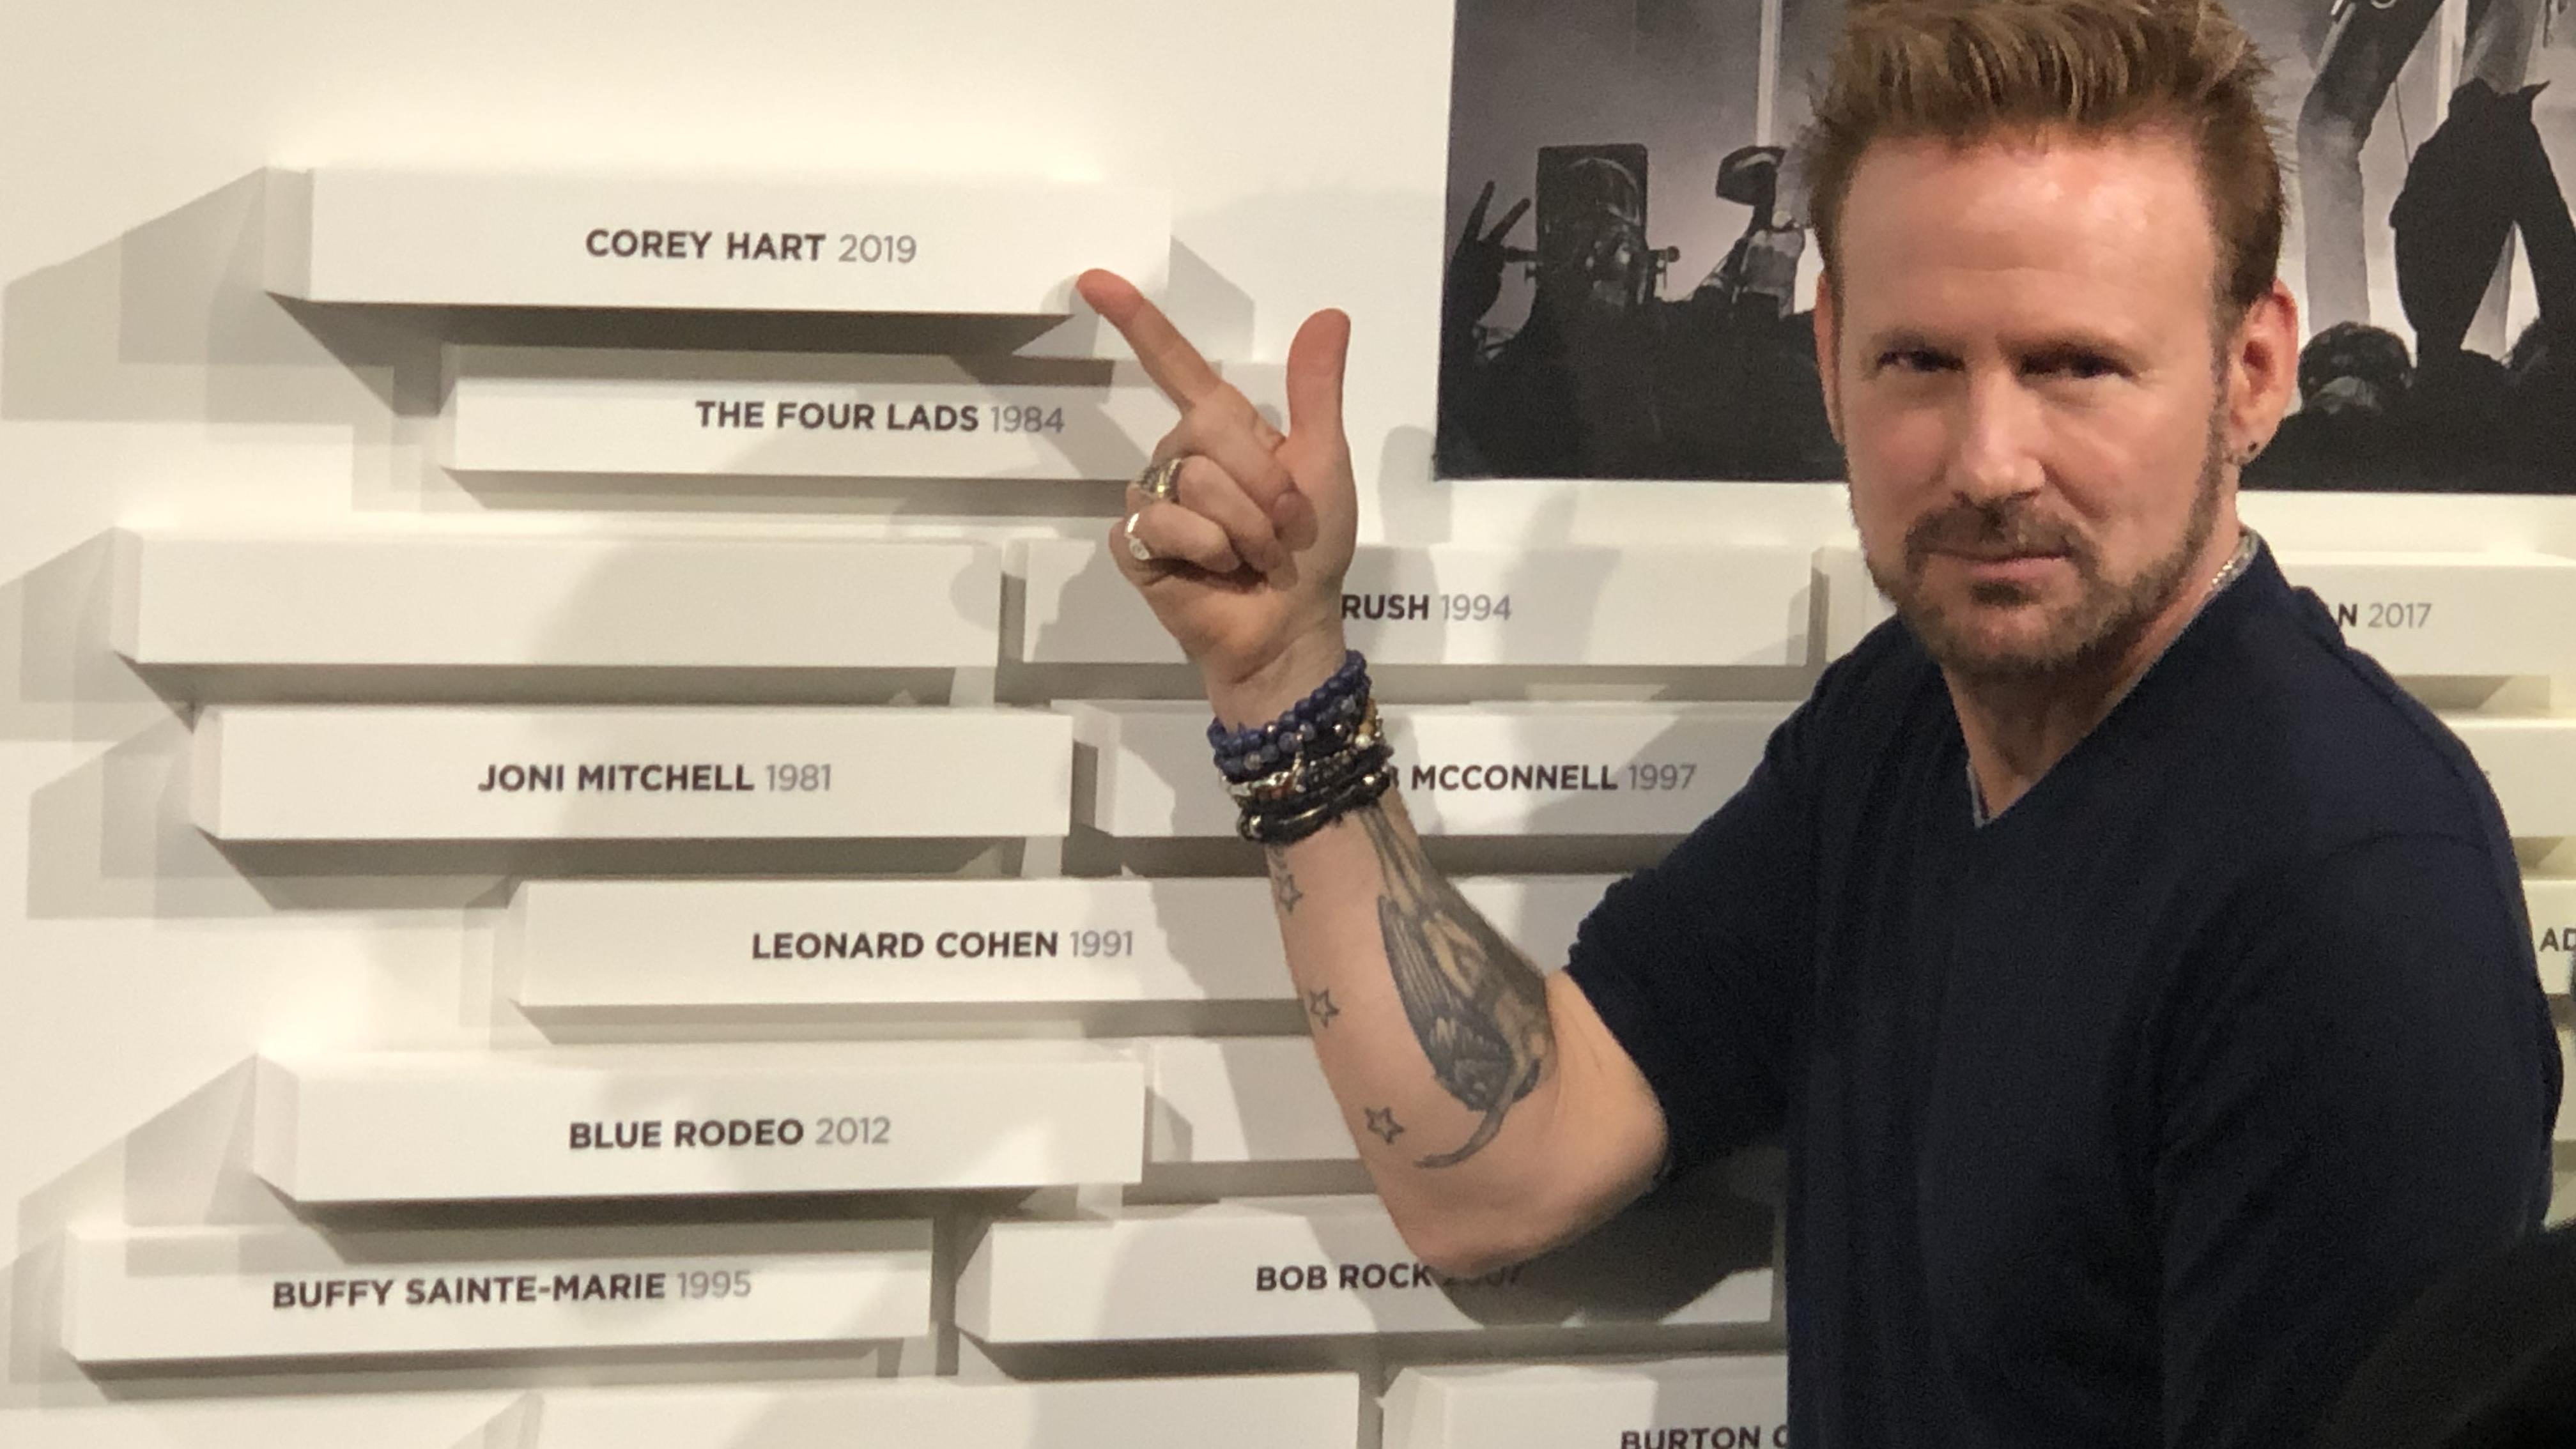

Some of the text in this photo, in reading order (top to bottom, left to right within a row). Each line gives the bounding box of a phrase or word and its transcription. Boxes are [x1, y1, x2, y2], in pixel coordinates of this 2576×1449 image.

[585, 228, 917, 264] COREY HART 2019
[696, 400, 1065, 434] THE FOUR LADS 1984
[1342, 593, 1512, 622] RUSH 1994
[2367, 602, 2433, 629] 2017
[477, 763, 831, 793] JONI MITCHELL 1981
[1410, 763, 1619, 792] MCCONNELL
[1628, 763, 1697, 791] 1997
[751, 930, 1134, 960] LEONARD COHEN 1991
[568, 1116, 891, 1151] BLUE RODEO 2012
[272, 1269, 752, 1310] BUFFY SAINTE-MARIE 1995
[1256, 1264, 1328, 1292] BOB
[1339, 1262, 1433, 1291] ROCK
[1621, 1425, 1761, 1449] BURTON
